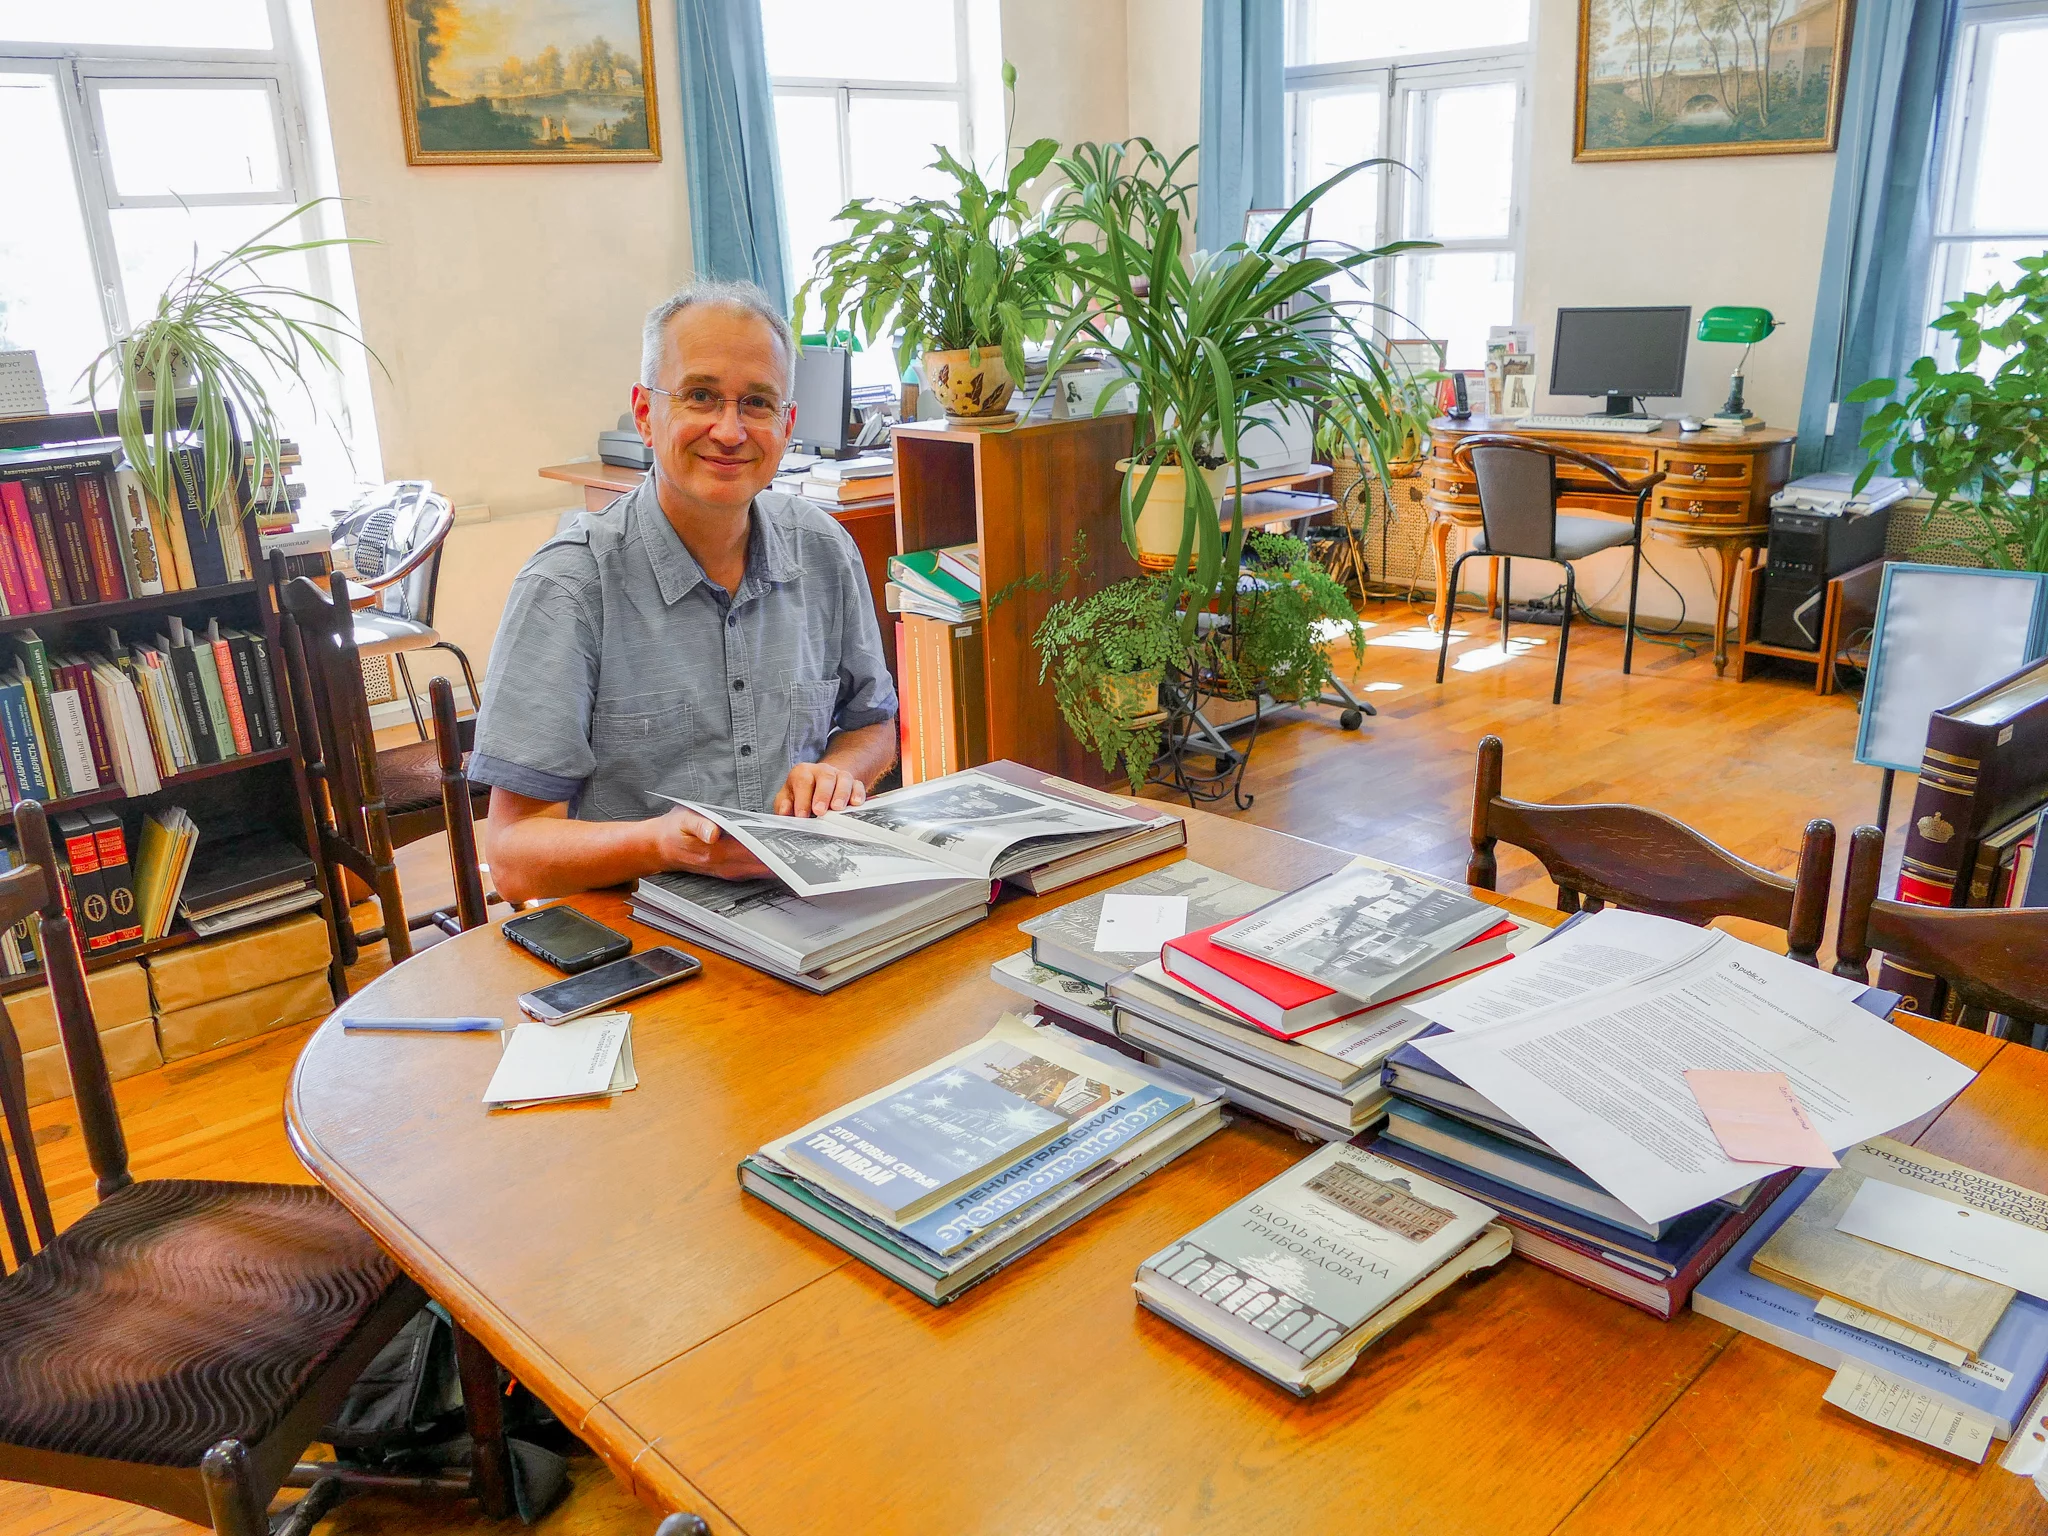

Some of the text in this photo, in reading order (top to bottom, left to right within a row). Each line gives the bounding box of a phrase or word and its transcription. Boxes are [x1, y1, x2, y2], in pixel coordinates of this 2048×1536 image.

[4, 466, 53, 476] Аннотированный
[66, 695, 81, 737] КЛАДБИЩА
[12, 746, 31, 791] ДЕКАБРИСТЫ
[27, 743, 45, 788] ДЕКАБРИСТЫ
[76, 738, 92, 782] ОТДЕЛЬНЫЕ
[1232, 918, 1272, 939] ПЕРВЫЕ
[1273, 916, 1330, 946] ЛЕНИНГРАДЕ
[1737, 966, 1768, 985] public.ru
[805, 1132, 898, 1186] ТРАМВАЙ
[828, 1126, 940, 1189] ЭТОТ НОВЫЙ СТАРЫЙ
[954, 1103, 1127, 1210] ЛЕНИНГРАДСКИЙ
[1859, 1144, 2048, 1216] ЕСТАВРАЦИОННЫХ
[1947, 1169, 2048, 1207] ЕРМИНОВ
[1963, 1196, 2048, 1232] СЛОВАРЬ
[1243, 1219, 1363, 1285] ГРИБОЕДОВА
[1249, 1204, 1308, 1239] ВДОЛЬ
[1312, 1236, 1391, 1280] КАНАЛА
[1738, 1289, 1801, 1319] ЭРМИТАЖА
[1806, 1314, 1931, 1369] ГОСУДАРСТВЕННОГО
[1934, 1367, 1978, 1389] ТРУДЫ
